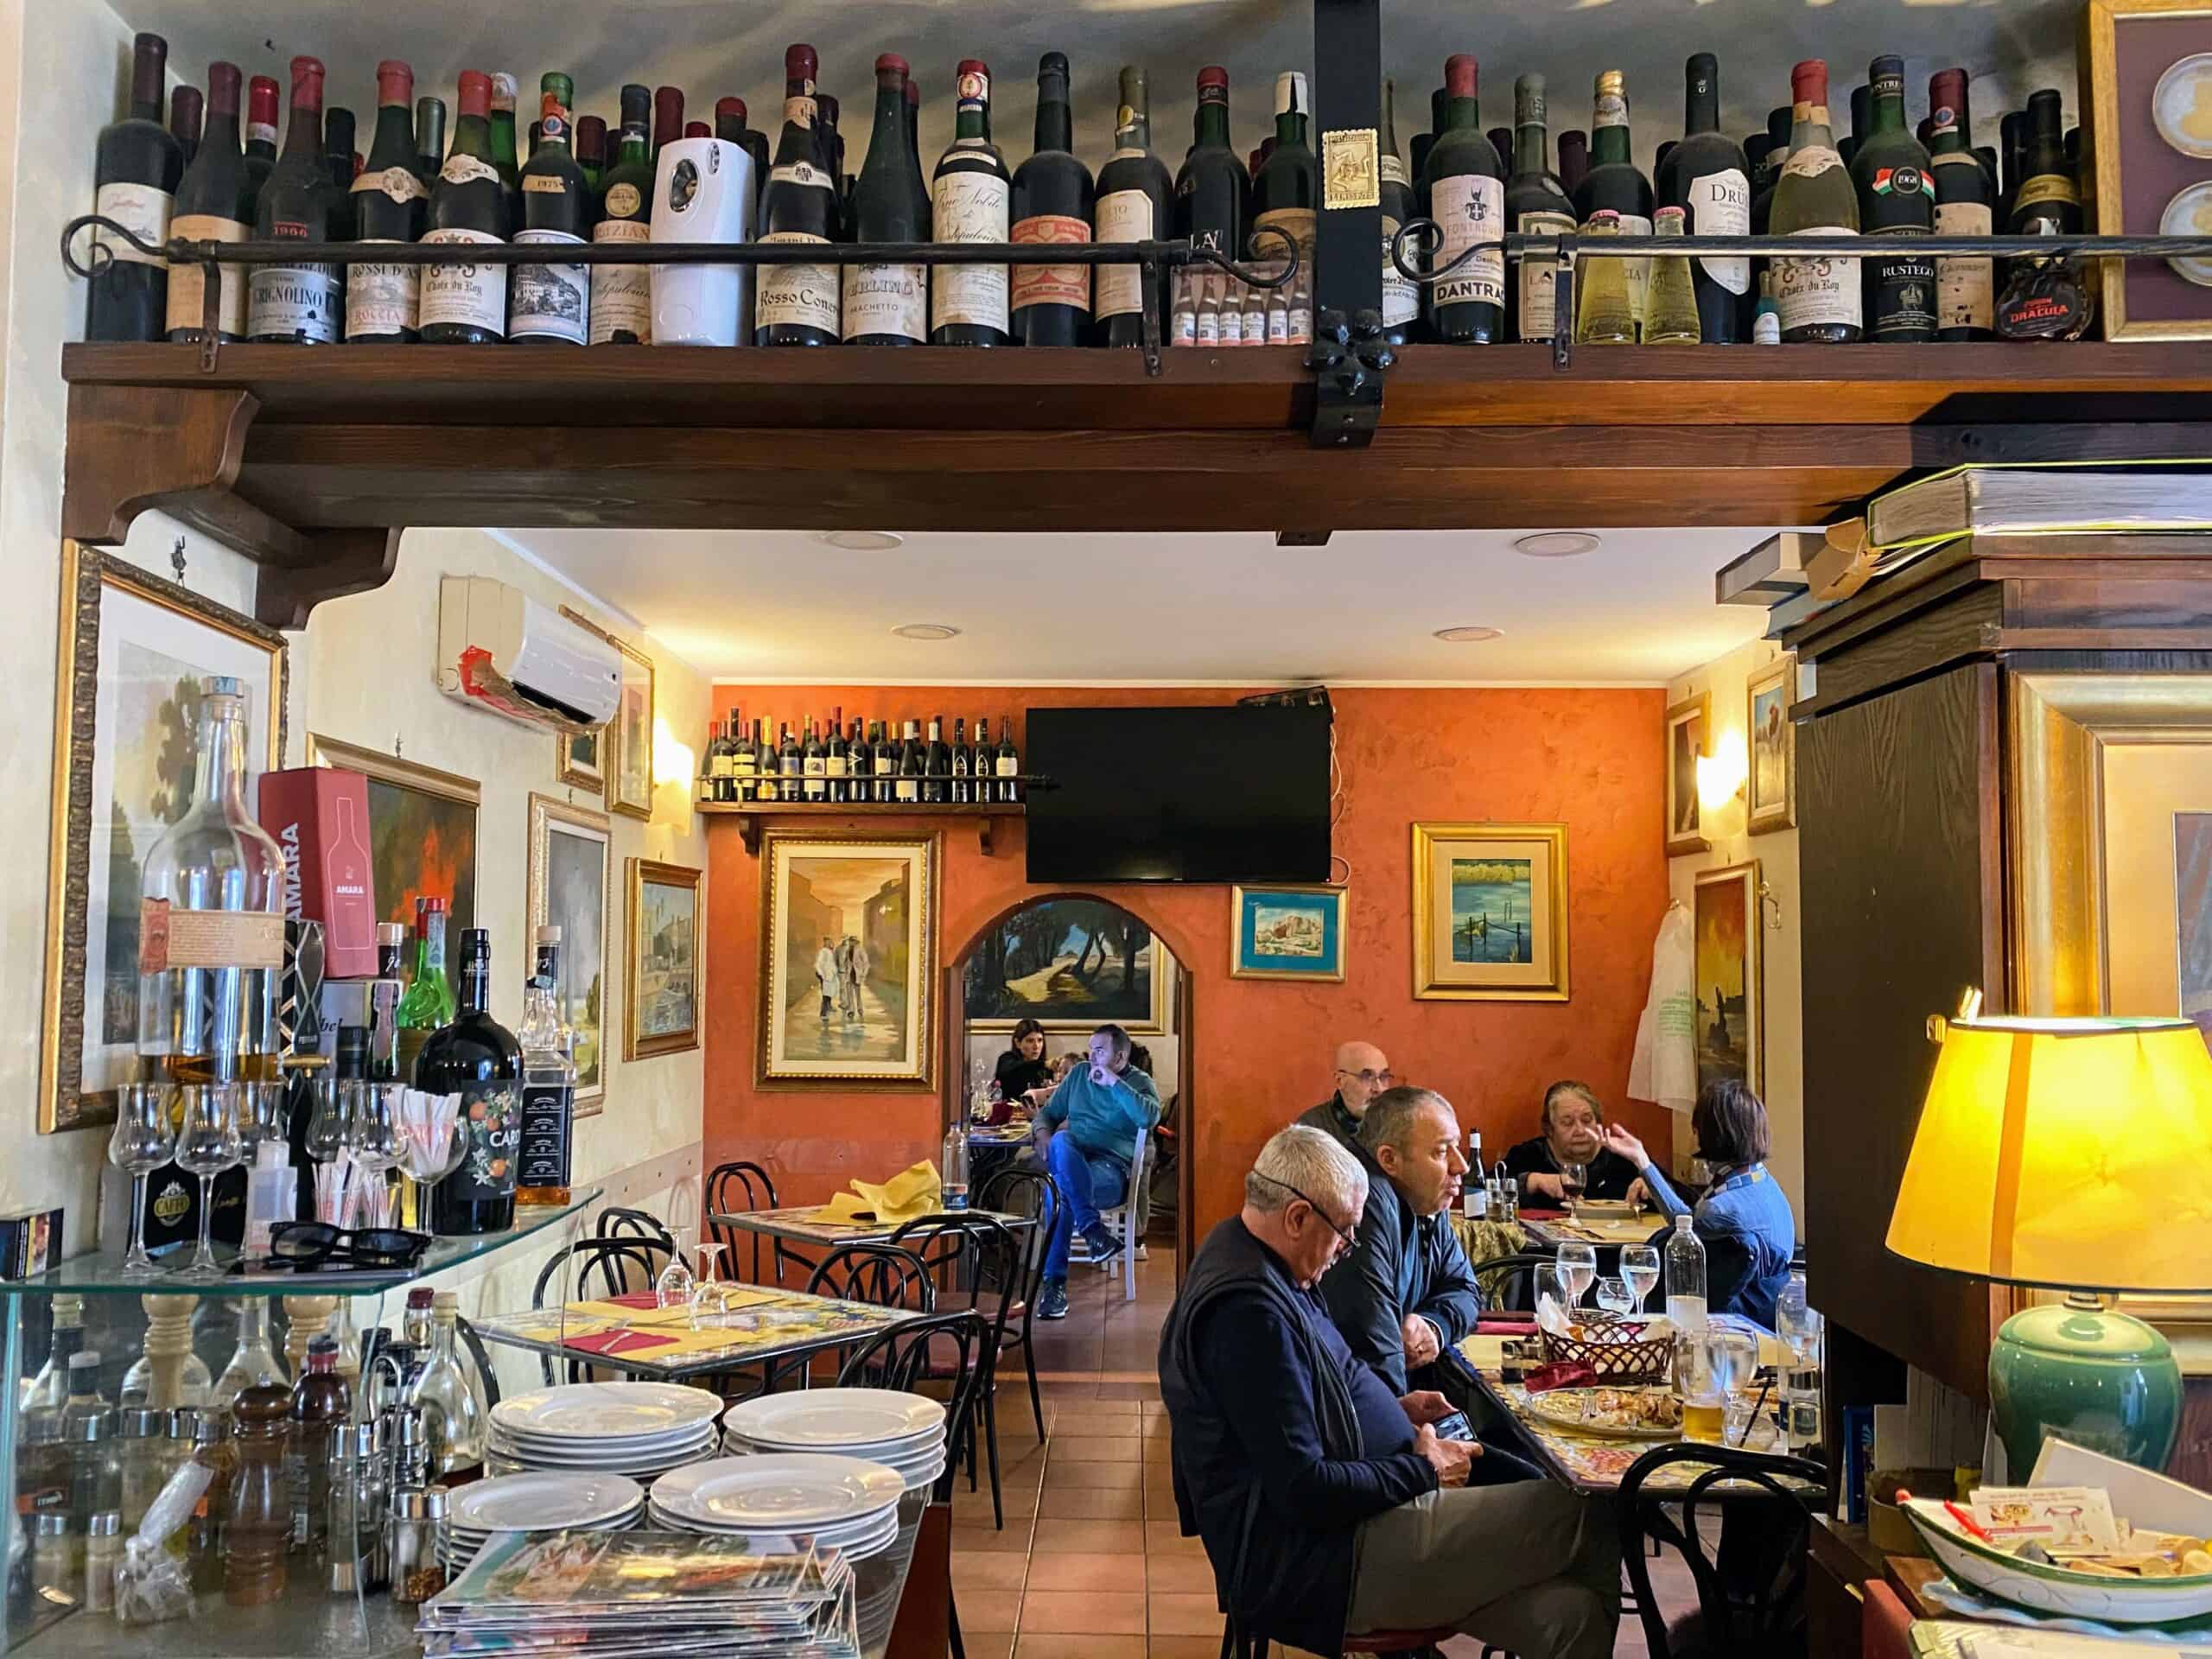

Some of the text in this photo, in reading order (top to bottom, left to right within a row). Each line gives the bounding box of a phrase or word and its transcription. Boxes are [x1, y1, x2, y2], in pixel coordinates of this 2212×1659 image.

[760, 289, 798, 308] Rosso
[280, 822, 302, 922] AMARA
[335, 885, 364, 894] AMARA
